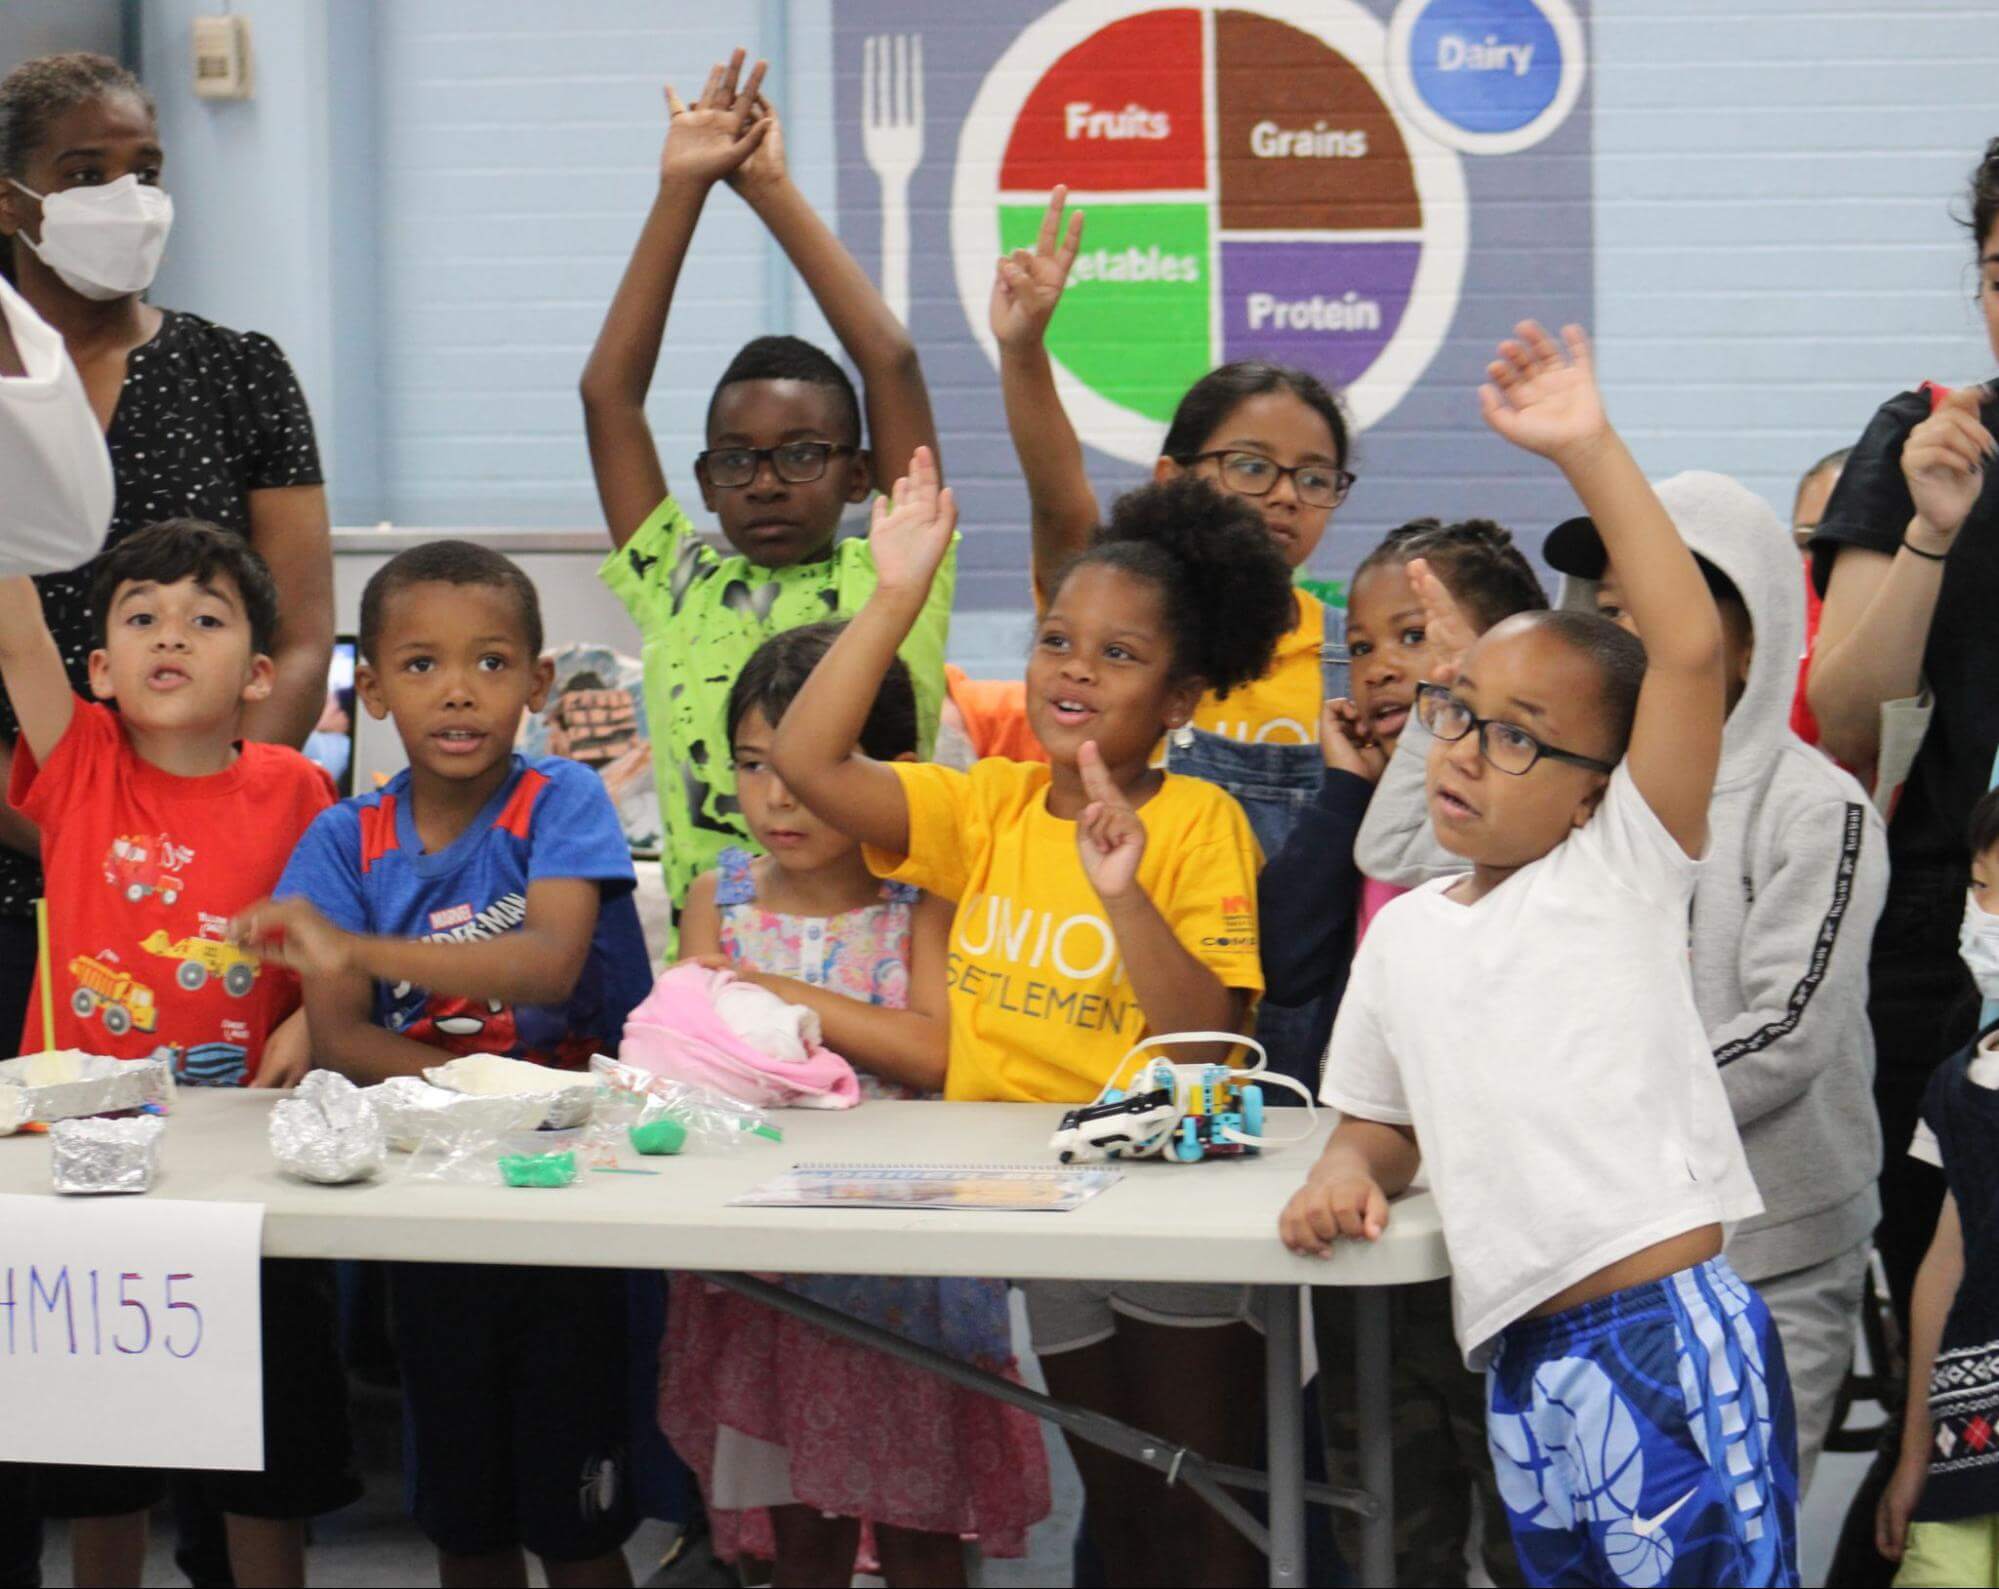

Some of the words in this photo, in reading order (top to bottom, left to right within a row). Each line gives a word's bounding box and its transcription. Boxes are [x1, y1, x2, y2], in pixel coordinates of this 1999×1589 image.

[1437, 35, 1533, 76] Dairy
[1065, 102, 1170, 139] Fruits
[1251, 120, 1368, 157] Grains
[1066, 246, 1198, 288] etables
[1247, 291, 1381, 330] Protein
[959, 895, 1126, 986] UNIO
